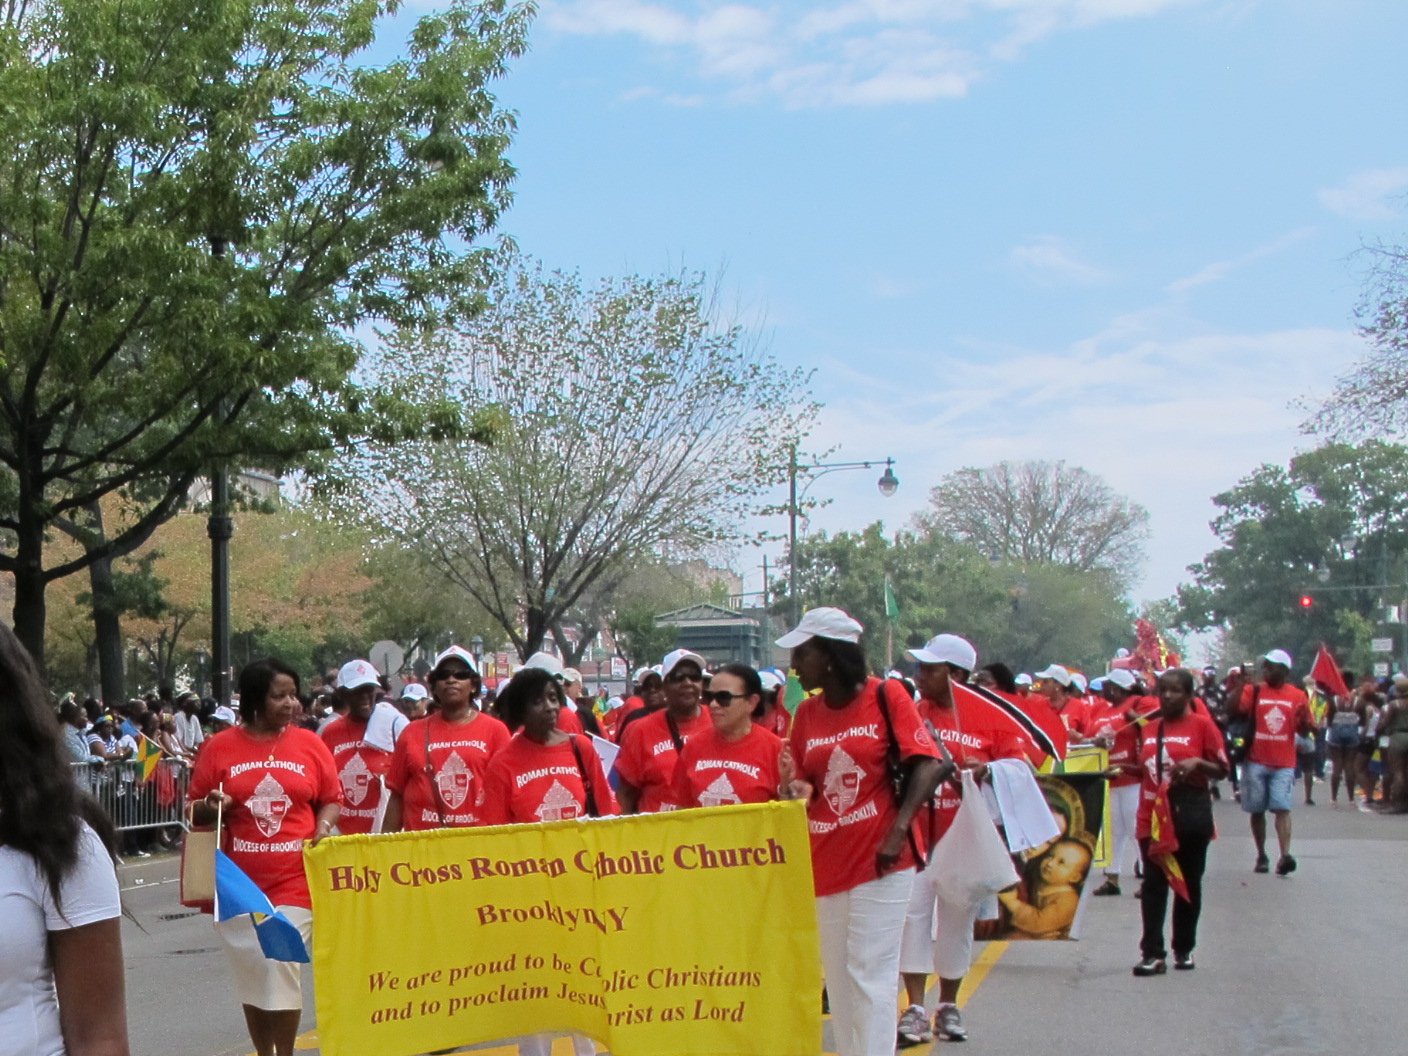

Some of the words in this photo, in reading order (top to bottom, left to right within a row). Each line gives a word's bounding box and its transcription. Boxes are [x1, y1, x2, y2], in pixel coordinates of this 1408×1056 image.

[837, 724, 879, 742] CATHOLIC
[451, 740, 488, 753] CATHOLIC
[230, 761, 263, 778] ROMAN
[263, 760, 306, 777] CATHOLIC
[516, 767, 549, 788] ROMAN
[695, 760, 723, 771] ROMAN
[723, 761, 760, 779] CATHOLIC
[233, 837, 260, 852] DIOCESE
[259, 842, 270, 853] OF
[328, 865, 382, 893] Holy
[390, 862, 463, 887] Cross
[467, 857, 568, 880] Roman
[673, 837, 786, 870] Church
[368, 970, 399, 993] We
[406, 969, 442, 990] are
[448, 953, 517, 986] proud
[525, 953, 545, 970] to
[553, 953, 572, 974] be
[647, 965, 761, 989] Christians
[370, 1001, 413, 1024] and
[420, 1000, 441, 1016] to
[447, 982, 550, 1016] proclaim
[557, 983, 606, 1009] Jesus
[661, 1006, 686, 1022] as
[693, 999, 745, 1022] Lord
